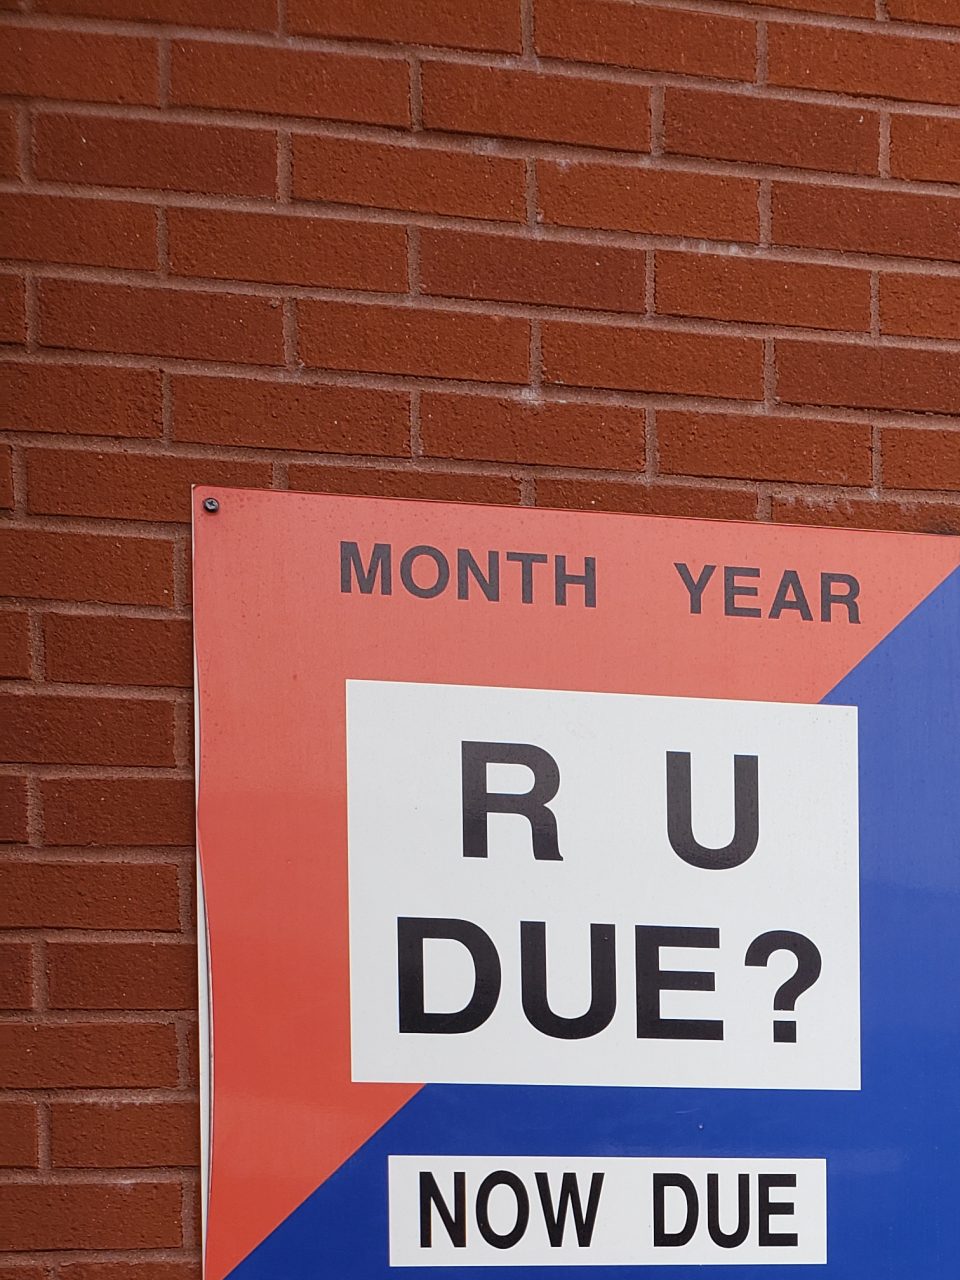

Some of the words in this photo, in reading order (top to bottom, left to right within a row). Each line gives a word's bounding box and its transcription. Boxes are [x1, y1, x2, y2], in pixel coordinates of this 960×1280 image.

[340, 541, 598, 608] MONTH
[674, 563, 861, 624] YEAR
[461, 740, 564, 862] R
[666, 750, 760, 871] U
[397, 916, 823, 1043] DUE?
[419, 1170, 604, 1250] NOW
[652, 1172, 799, 1249] DUE
